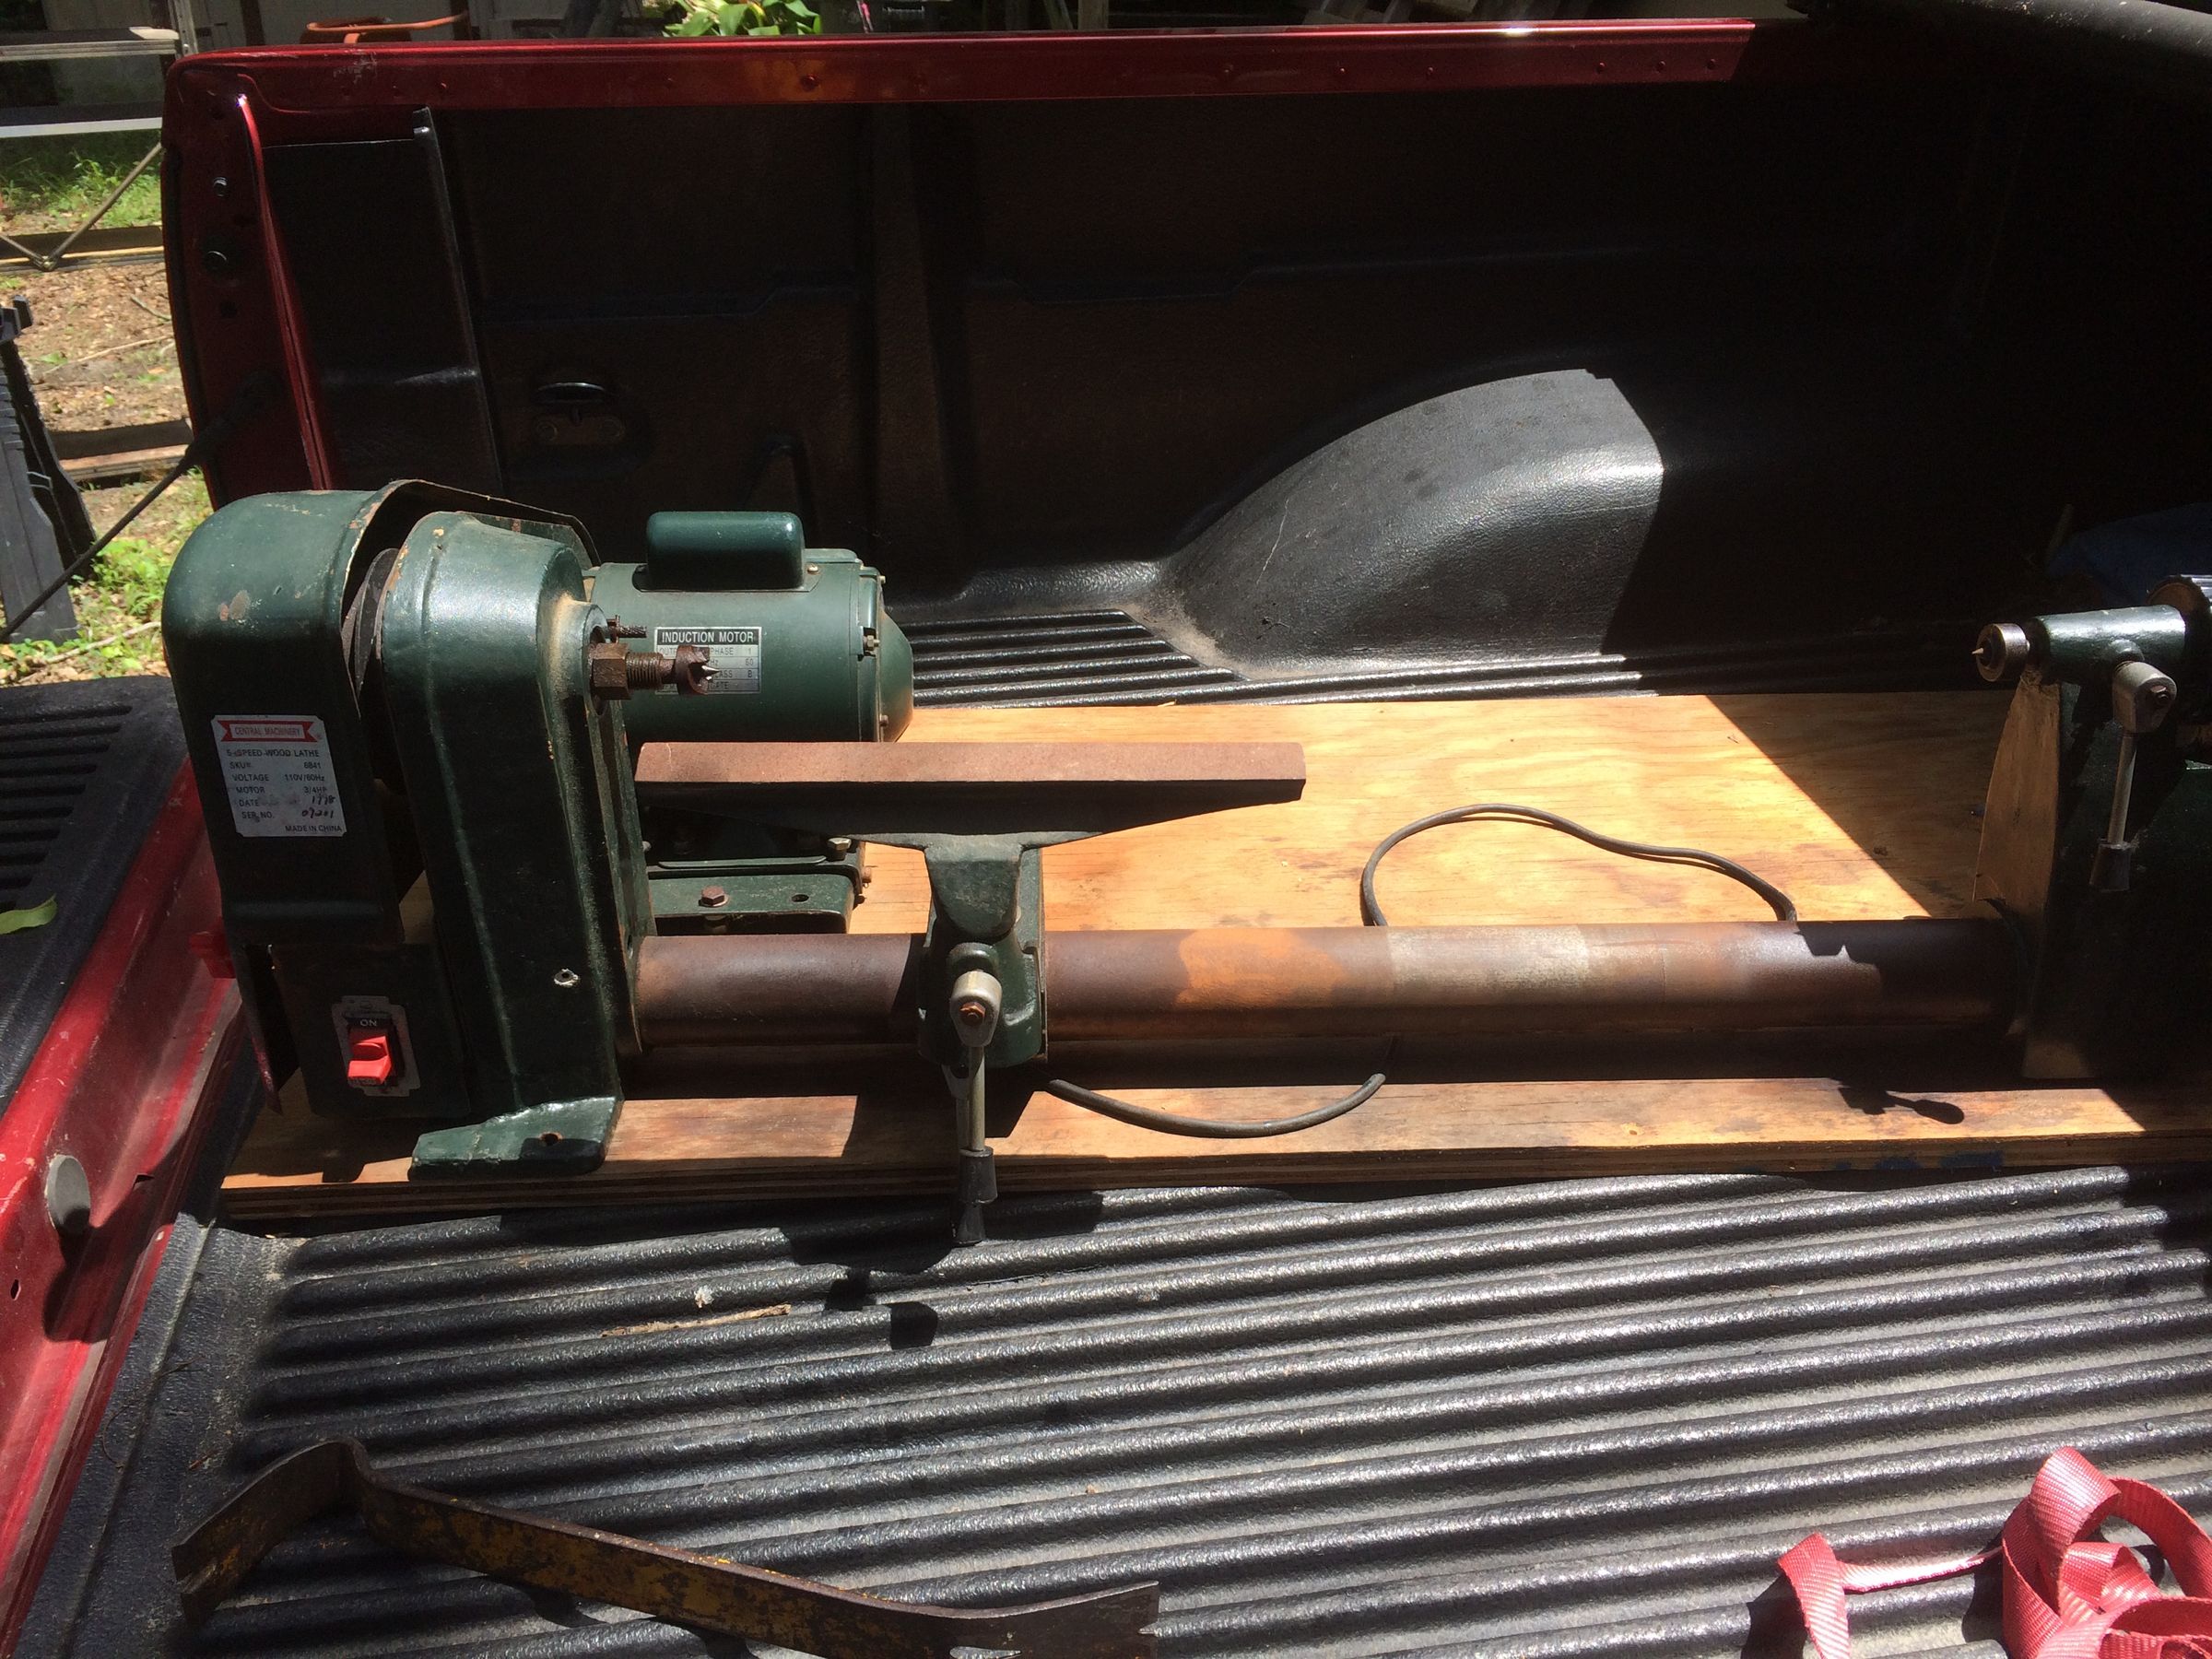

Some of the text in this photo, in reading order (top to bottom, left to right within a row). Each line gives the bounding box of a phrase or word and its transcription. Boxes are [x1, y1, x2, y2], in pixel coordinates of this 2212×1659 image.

[662, 631, 754, 643] INDUCTION MOTOR
[659, 647, 677, 655] OUT
[711, 647, 735, 655] PHASE
[234, 726, 301, 735] CENTRAL MACHINERY
[294, 749, 320, 758] LATHE
[232, 773, 270, 782] VOLTAGE
[359, 1018, 377, 1027] ON
